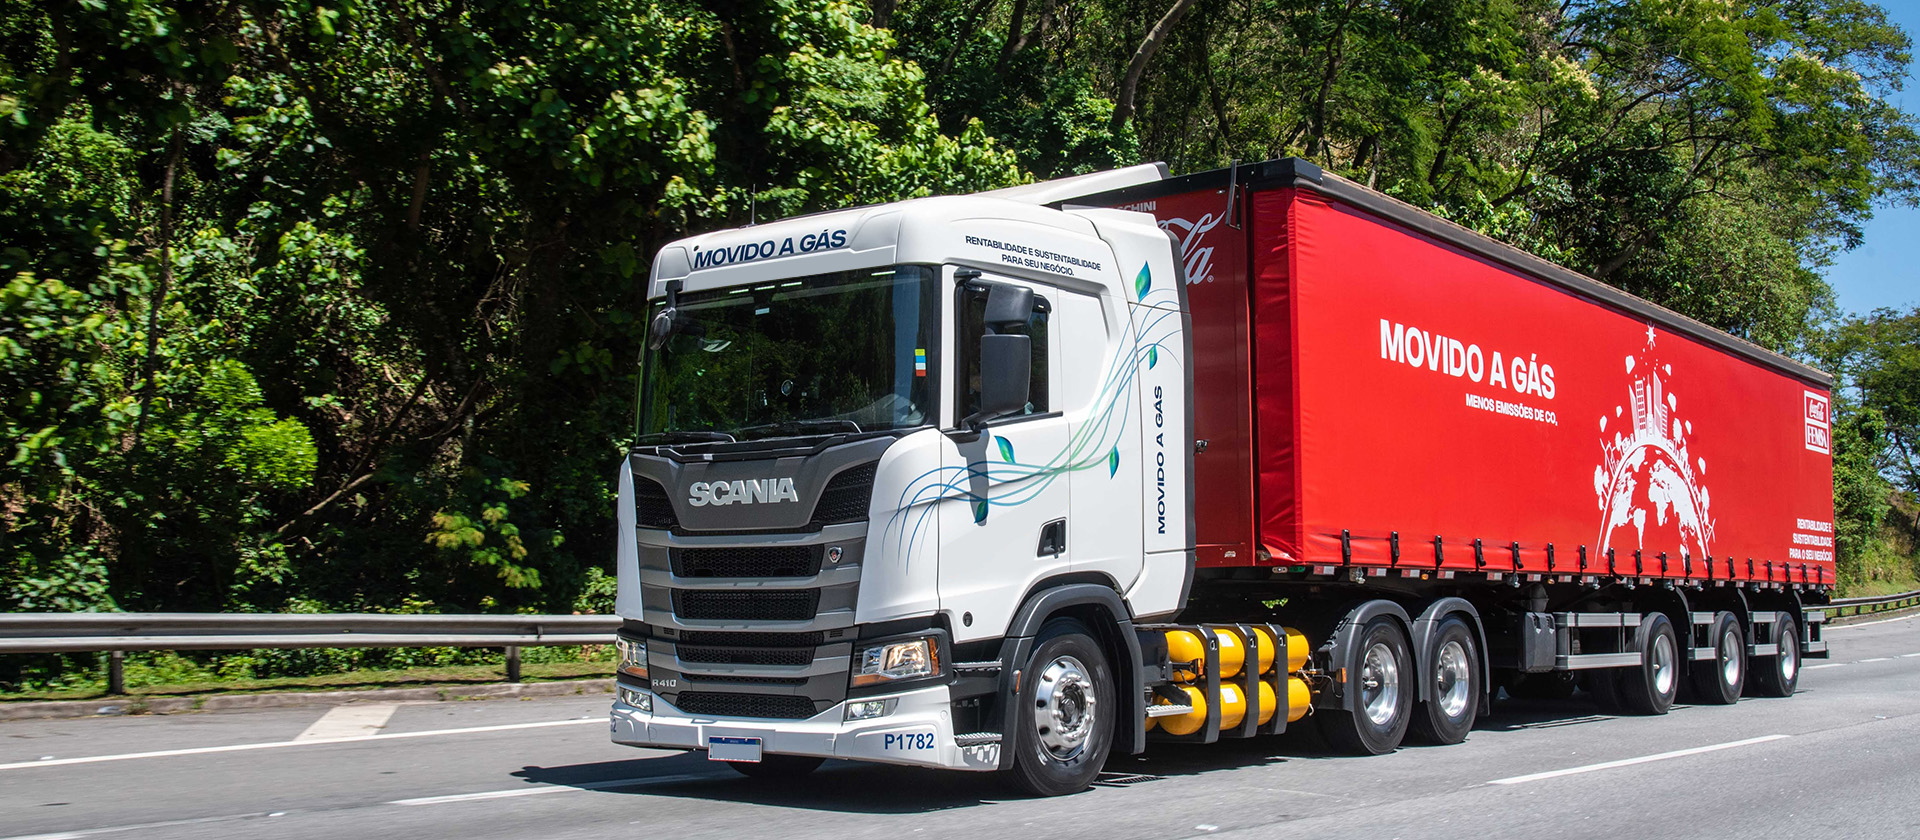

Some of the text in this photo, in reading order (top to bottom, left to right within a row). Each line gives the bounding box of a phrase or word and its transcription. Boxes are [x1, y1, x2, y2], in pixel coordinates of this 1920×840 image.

[694, 229, 847, 269] MOVIDO A GÁS
[965, 235, 1101, 271] RENTABILIDADE E SUSTENTABILIDADE
[1001, 253, 1075, 276] PARA SEU NEGÓCIO.
[1380, 318, 1556, 400] MOVIDO A GÁS
[1465, 393, 1495, 412] MENOS
[1495, 400, 1534, 420] EMISSÕES
[1534, 408, 1545, 422] DE
[1156, 432, 1164, 448] A
[688, 477, 799, 507] SCANIA
[1156, 451, 1166, 534] MOVIDO
[884, 732, 935, 750] P1782
